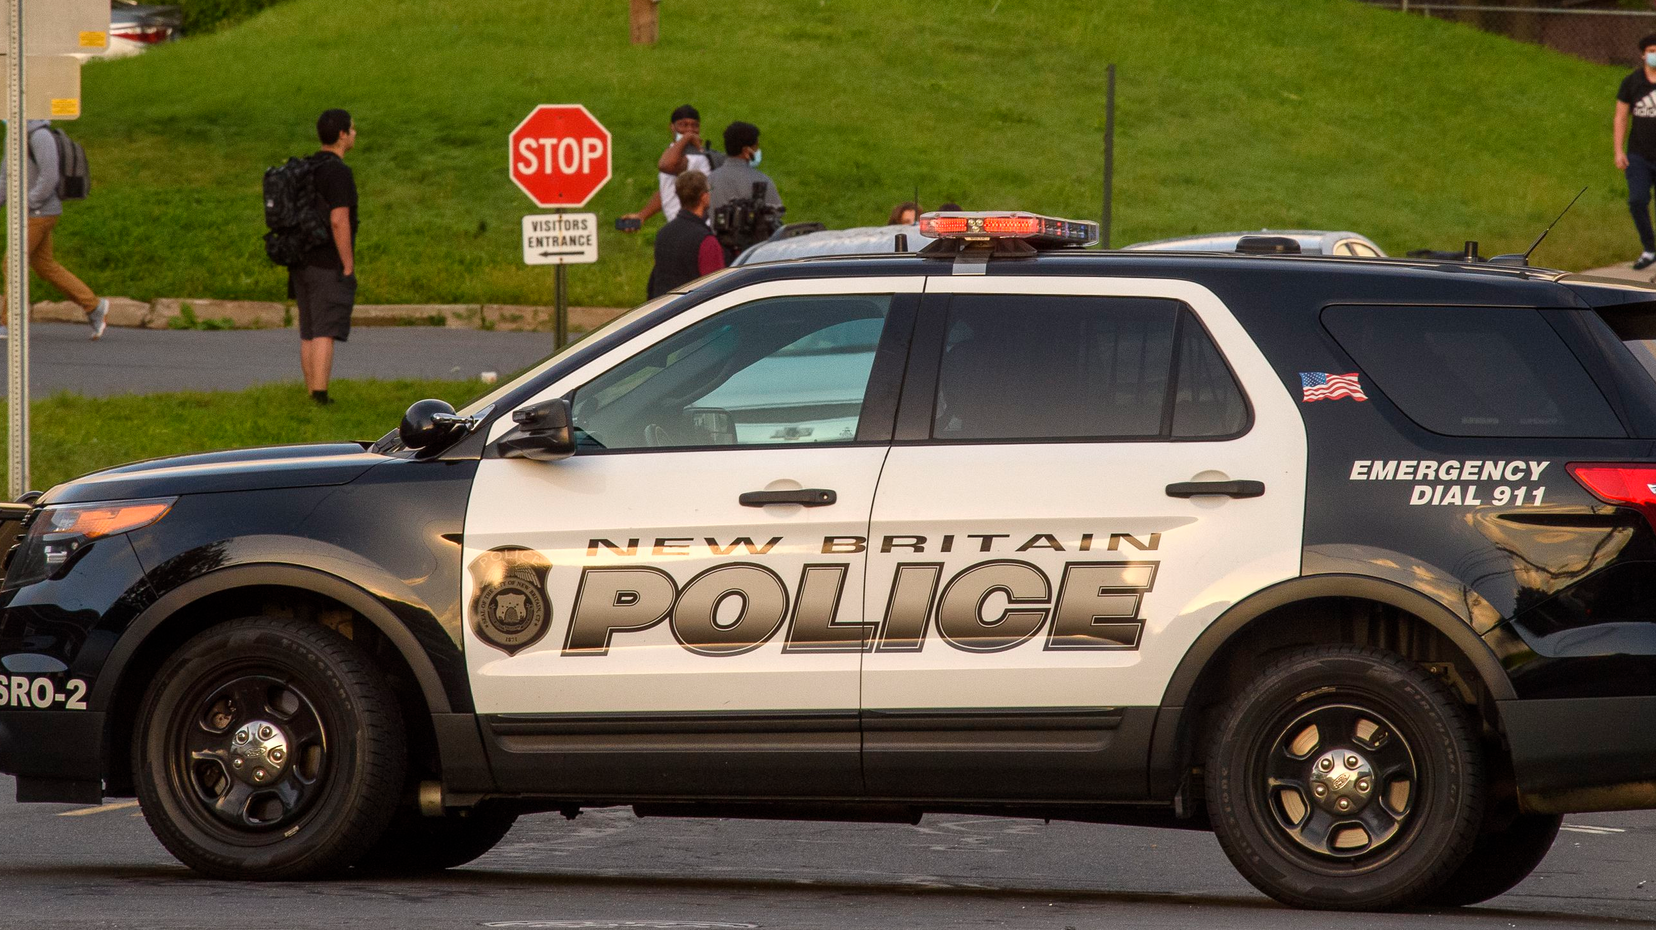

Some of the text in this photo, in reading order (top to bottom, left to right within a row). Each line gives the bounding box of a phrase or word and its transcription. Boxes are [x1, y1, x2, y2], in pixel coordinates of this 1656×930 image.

[517, 137, 604, 175] STOP
[531, 219, 588, 232] VISITORS
[528, 234, 593, 248] ENTRANCE
[1349, 460, 1550, 481] EMERGENCY
[1409, 485, 1546, 507] DIAL 911
[585, 532, 1162, 557] NEW BRITAIN
[479, 549, 542, 568] POLICE
[560, 559, 1160, 657] POLICE
